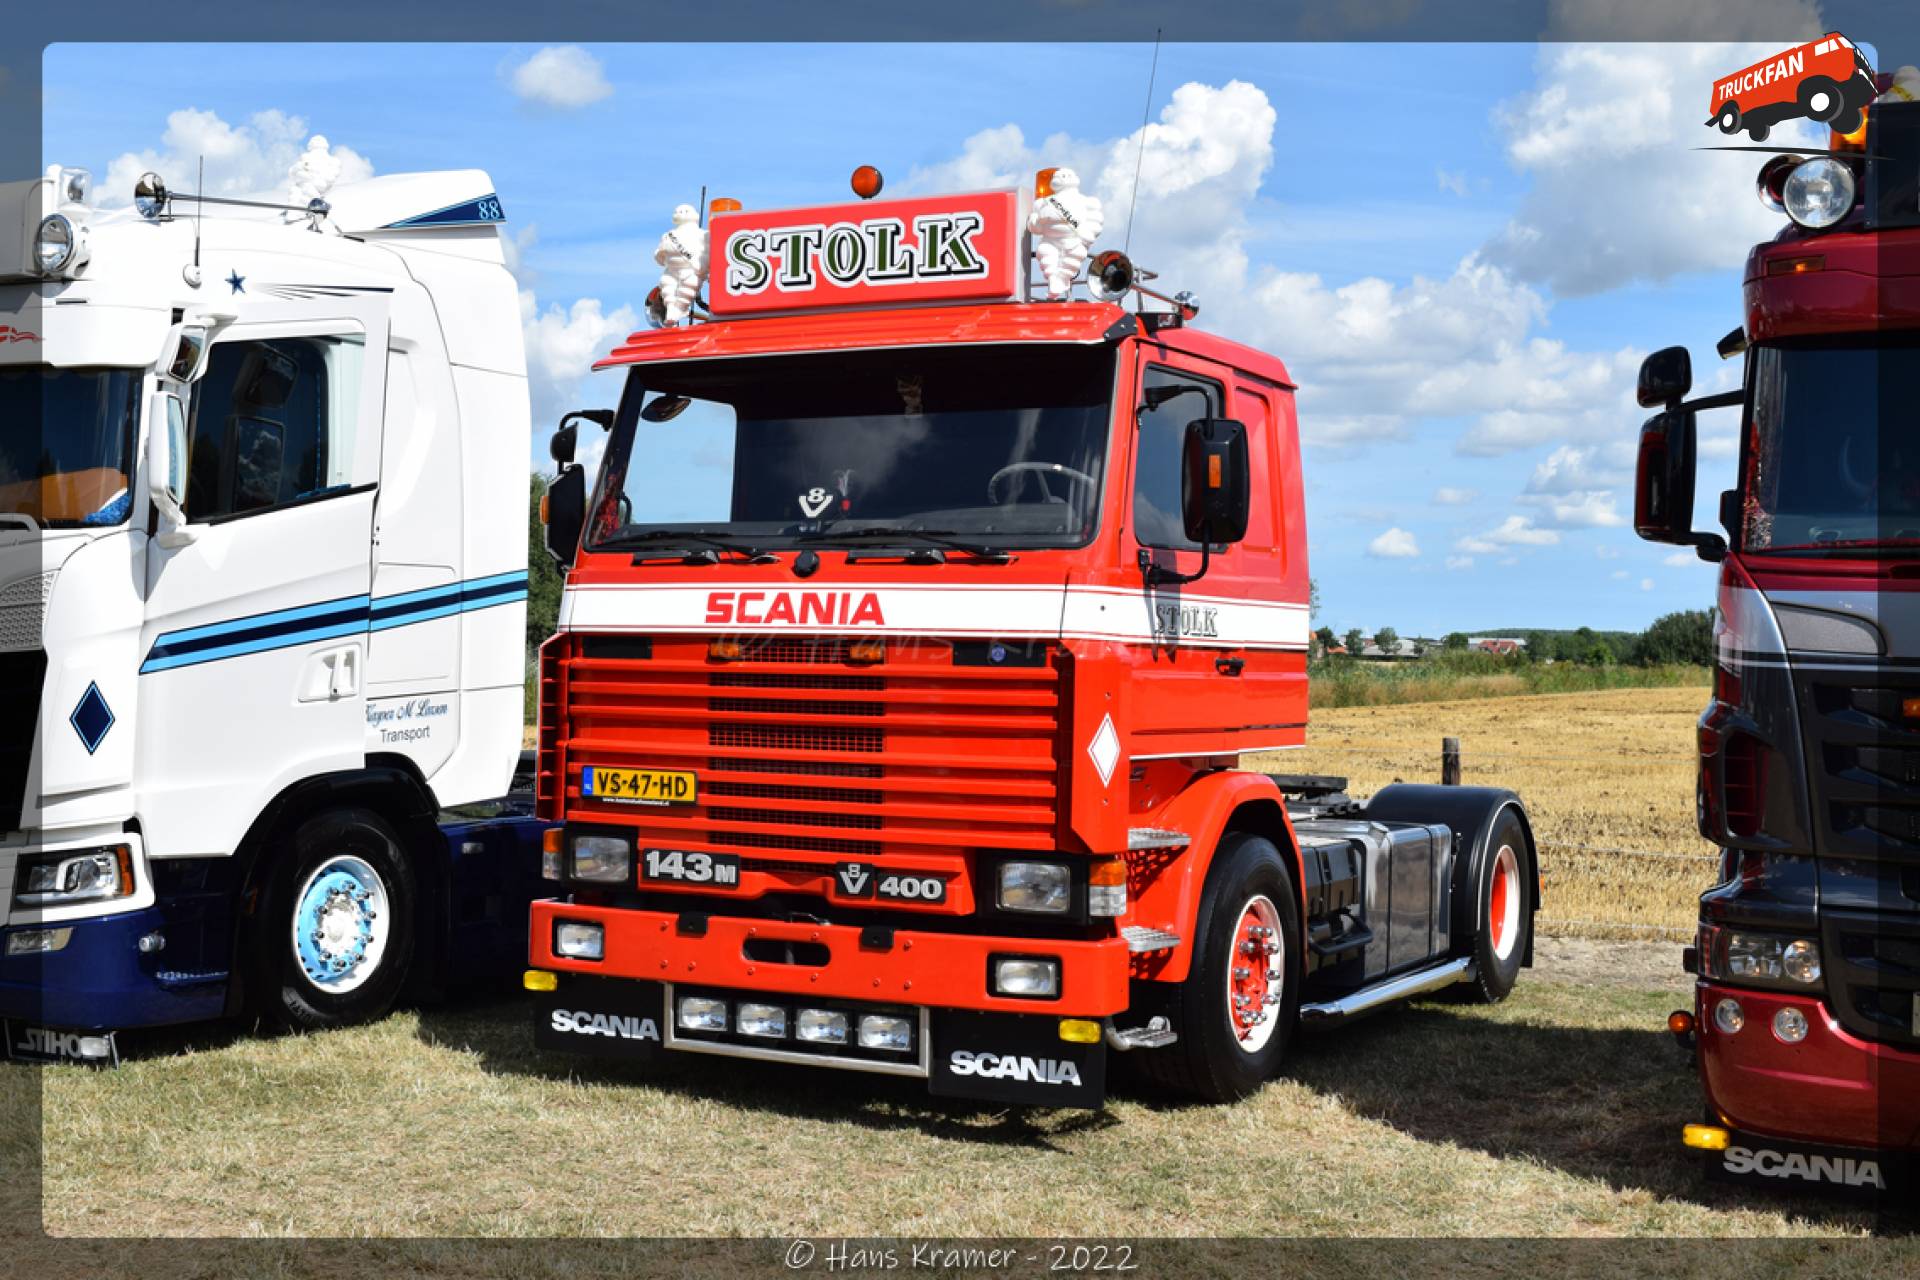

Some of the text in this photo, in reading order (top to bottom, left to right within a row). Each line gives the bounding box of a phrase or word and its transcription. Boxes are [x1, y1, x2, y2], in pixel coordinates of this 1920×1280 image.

[478, 200, 500, 220] 88
[728, 212, 988, 294] STOLK
[705, 591, 885, 626] SCANIA
[1154, 604, 1218, 638] STOLK
[380, 725, 430, 743] Transport
[598, 771, 688, 797] VS-47-HD
[879, 876, 942, 900] 400
[551, 1009, 660, 1041] SCANIA
[17, 1028, 86, 1059] STIHO
[949, 1050, 1082, 1086] SCANIA
[1723, 1146, 1887, 1190] SCANIA
